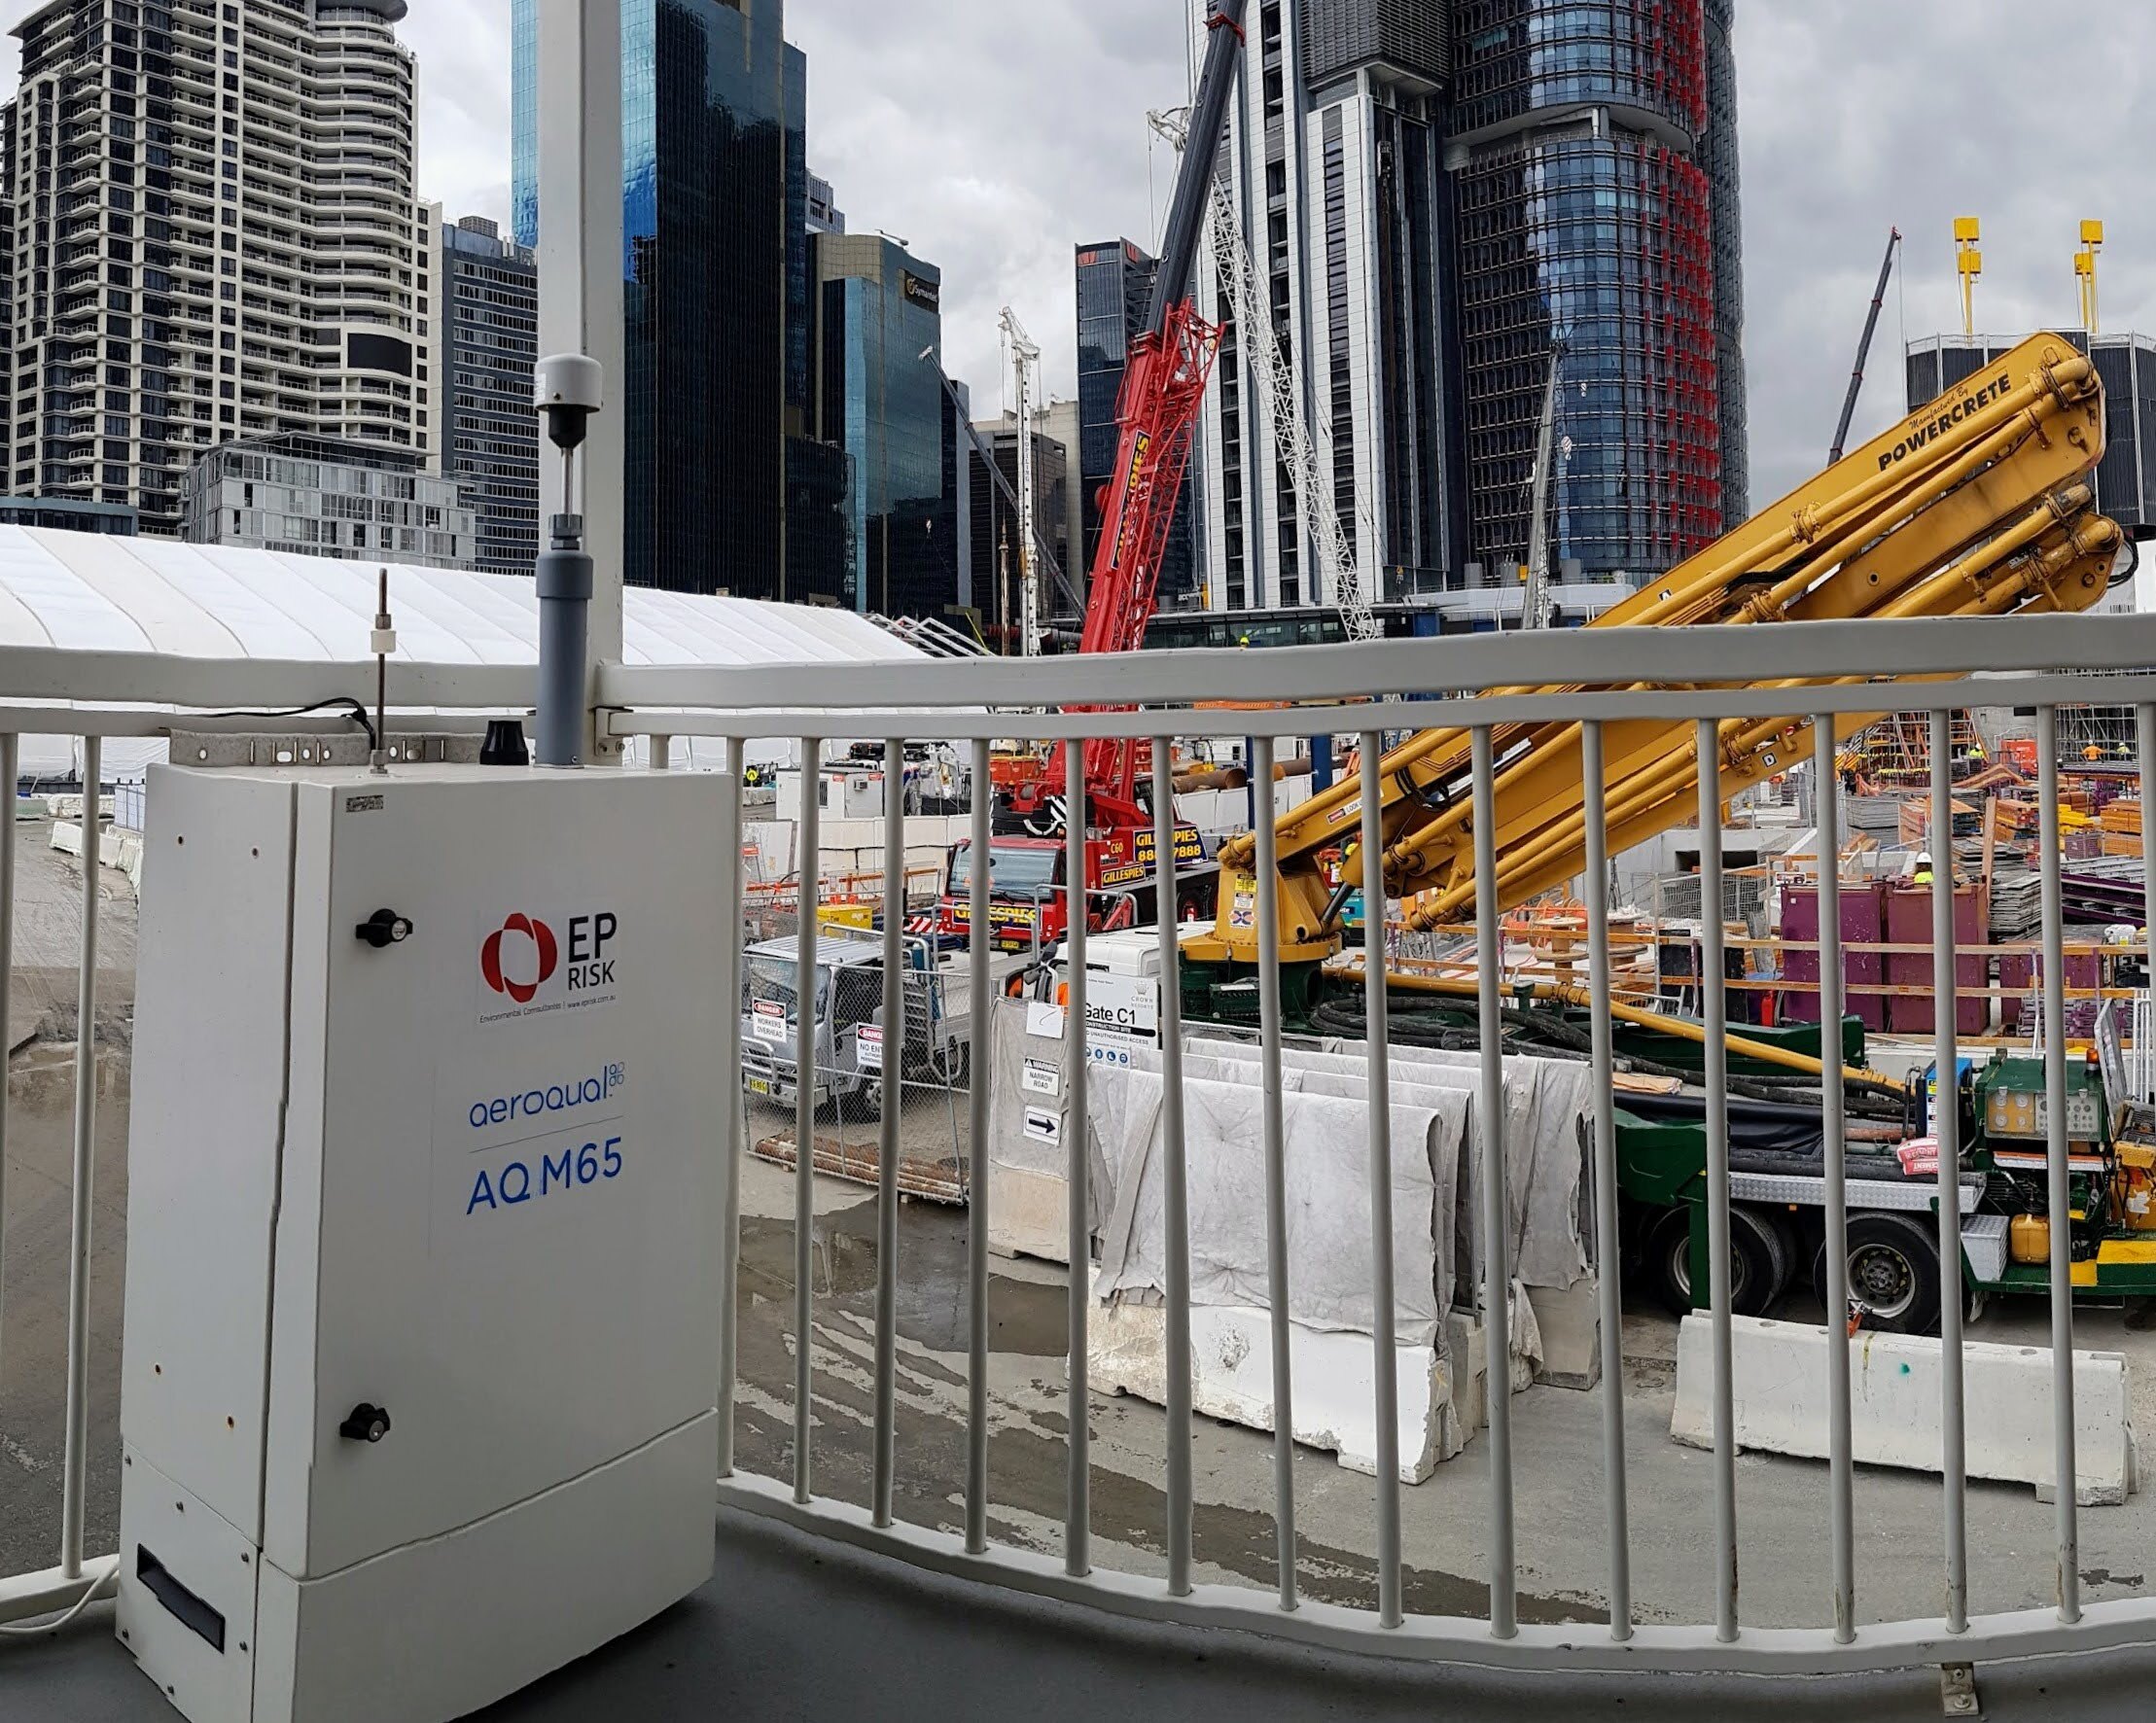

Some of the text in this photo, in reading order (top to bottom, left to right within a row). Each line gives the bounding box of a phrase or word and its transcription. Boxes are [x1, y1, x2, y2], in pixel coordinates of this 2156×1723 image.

[1878, 373, 2011, 472] POWERCRETE
[1763, 754, 1775, 766] D
[1103, 865, 1144, 883] GILLESPIES
[568, 912, 618, 964] EP
[568, 960, 616, 991] RISK
[757, 1004, 783, 1015] DANGER
[1116, 1007, 1135, 1025] C1
[479, 1010, 521, 1023] Environmental
[758, 1018, 782, 1029] WORKERS
[757, 1026, 783, 1037] OVERHEAD
[1090, 1031, 1128, 1042] UNAUTHORISED
[1129, 1037, 1149, 1045] ACCESS
[1034, 1060, 1058, 1072] WARNING
[1029, 1072, 1053, 1082] NARROW
[1033, 1080, 1048, 1089] ROAD
[469, 1065, 608, 1128] aeroqual
